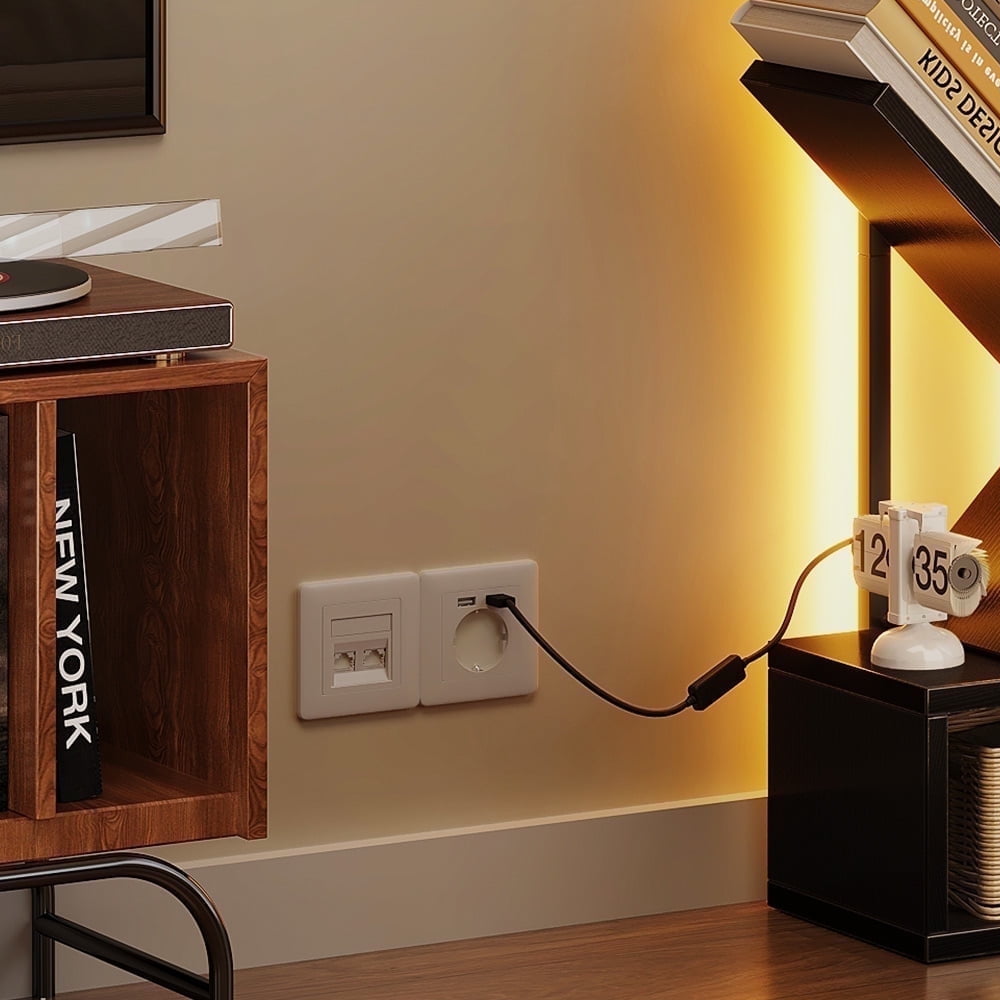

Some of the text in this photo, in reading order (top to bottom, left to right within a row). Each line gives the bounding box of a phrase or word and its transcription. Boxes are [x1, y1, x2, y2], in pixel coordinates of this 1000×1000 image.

[855, 530, 887, 579] 12
[915, 545, 949, 595] 35
[56, 613, 93, 750] YORK
